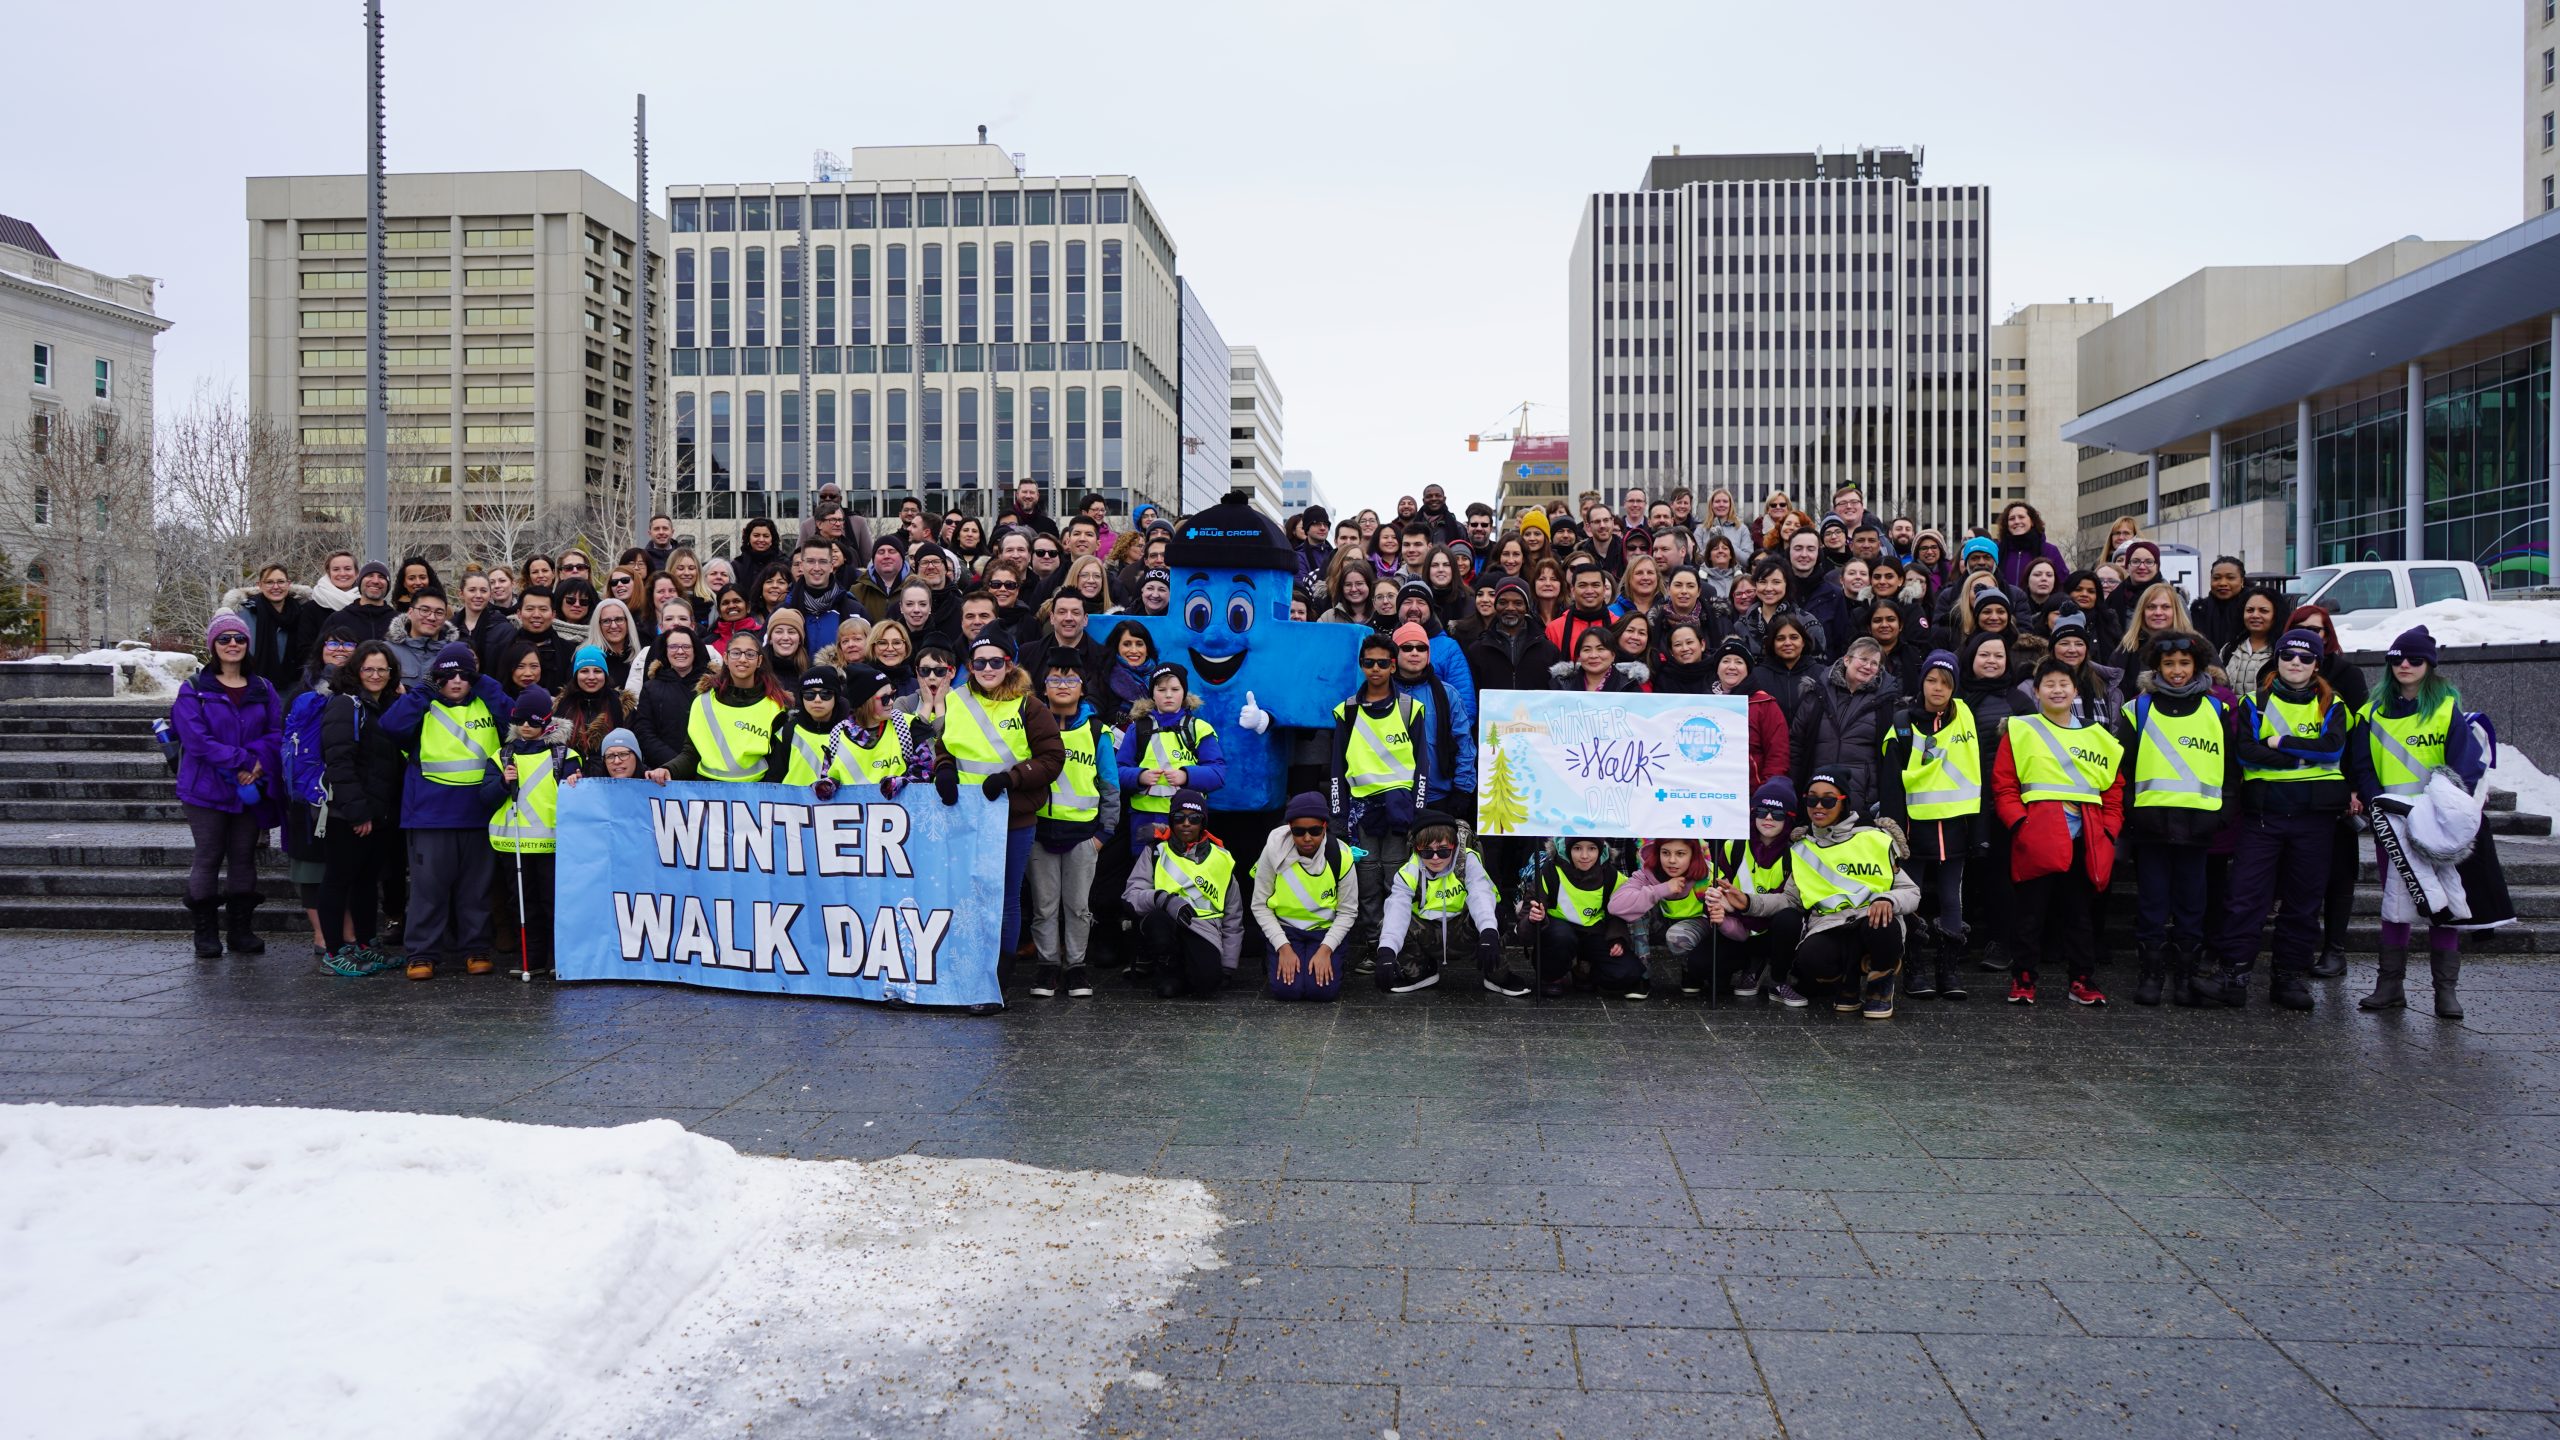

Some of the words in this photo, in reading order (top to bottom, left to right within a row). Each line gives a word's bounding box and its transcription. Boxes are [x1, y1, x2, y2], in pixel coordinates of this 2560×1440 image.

[2291, 640, 2310, 648] AMA
[442, 660, 459, 668] AMA
[742, 721, 769, 739] AMA
[1543, 700, 1634, 746] WINTER
[1393, 731, 1411, 745] AM
[1678, 727, 1722, 745] walk
[2188, 736, 2219, 755] AMA
[1580, 737, 1653, 787] Walk
[2079, 749, 2108, 770] AMA
[1816, 775, 1835, 784] AMA
[1331, 777, 1341, 814] PRESS
[1416, 774, 1427, 809] START
[1699, 792, 1737, 800] CROSS
[1187, 802, 1202, 811] AMA
[1584, 784, 1634, 829] DAY
[1766, 799, 1783, 808] AMA
[518, 841, 538, 849] SAFETY
[539, 842, 556, 850] PATRO
[648, 797, 914, 878] WINTER
[1846, 863, 1883, 876] AMA
[1202, 879, 1219, 902] AMA
[613, 891, 810, 976] WALK
[821, 903, 954, 985] DAY
